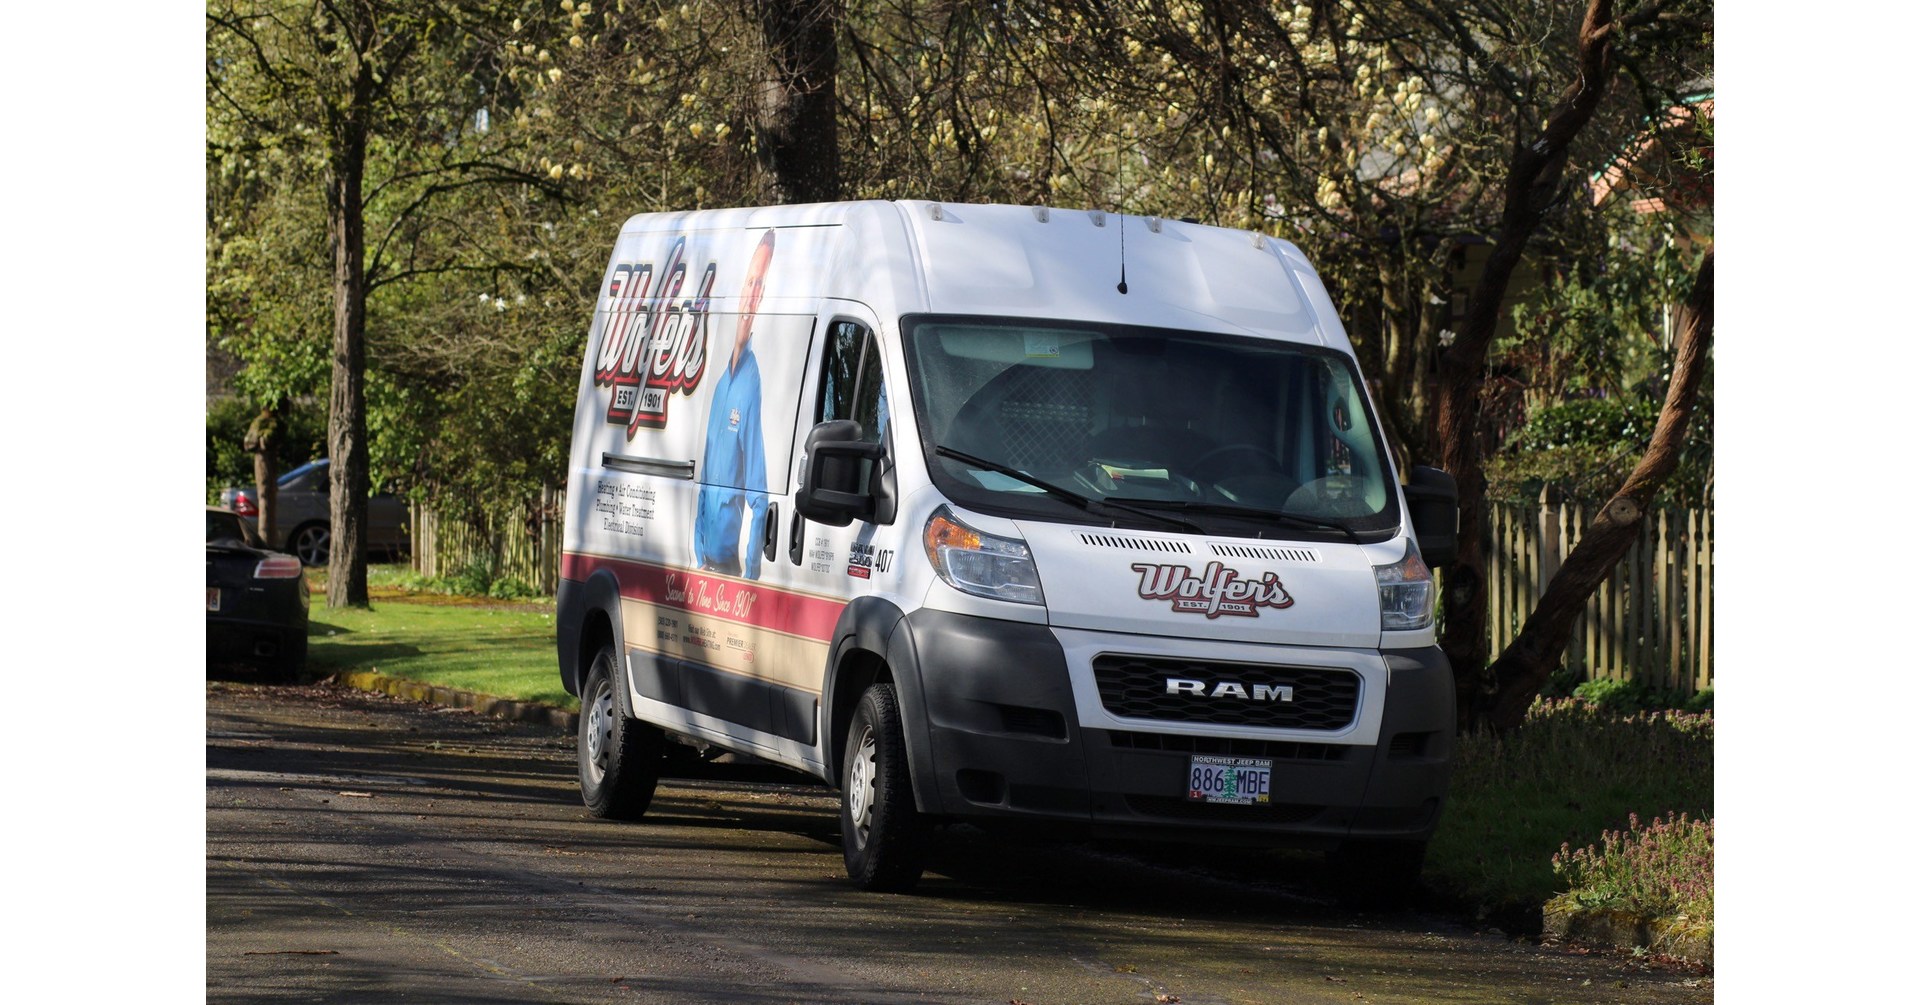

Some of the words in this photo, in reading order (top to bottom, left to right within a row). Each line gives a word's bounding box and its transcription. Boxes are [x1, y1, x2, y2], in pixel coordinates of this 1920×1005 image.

[594, 236, 716, 442] Wolfer's
[617, 390, 634, 405] EST.
[643, 393, 662, 408] 1901
[597, 480, 615, 499] Heating
[626, 484, 656, 506] Conditioning
[596, 498, 615, 518] Plumbing
[603, 517, 624, 533] Electrical
[624, 520, 644, 537] Division
[875, 549, 895, 573] 407
[687, 587, 695, 605] to
[696, 579, 713, 609] None
[713, 583, 732, 613] Since
[1131, 561, 1294, 620] Wolfer's
[1182, 601, 1208, 609] EST.
[1221, 603, 1246, 612] 1901
[1166, 678, 1293, 702] RAM
[1193, 755, 1237, 765] NORTHWEST
[1191, 767, 1225, 793] 886
[1236, 769, 1270, 795] MBE
